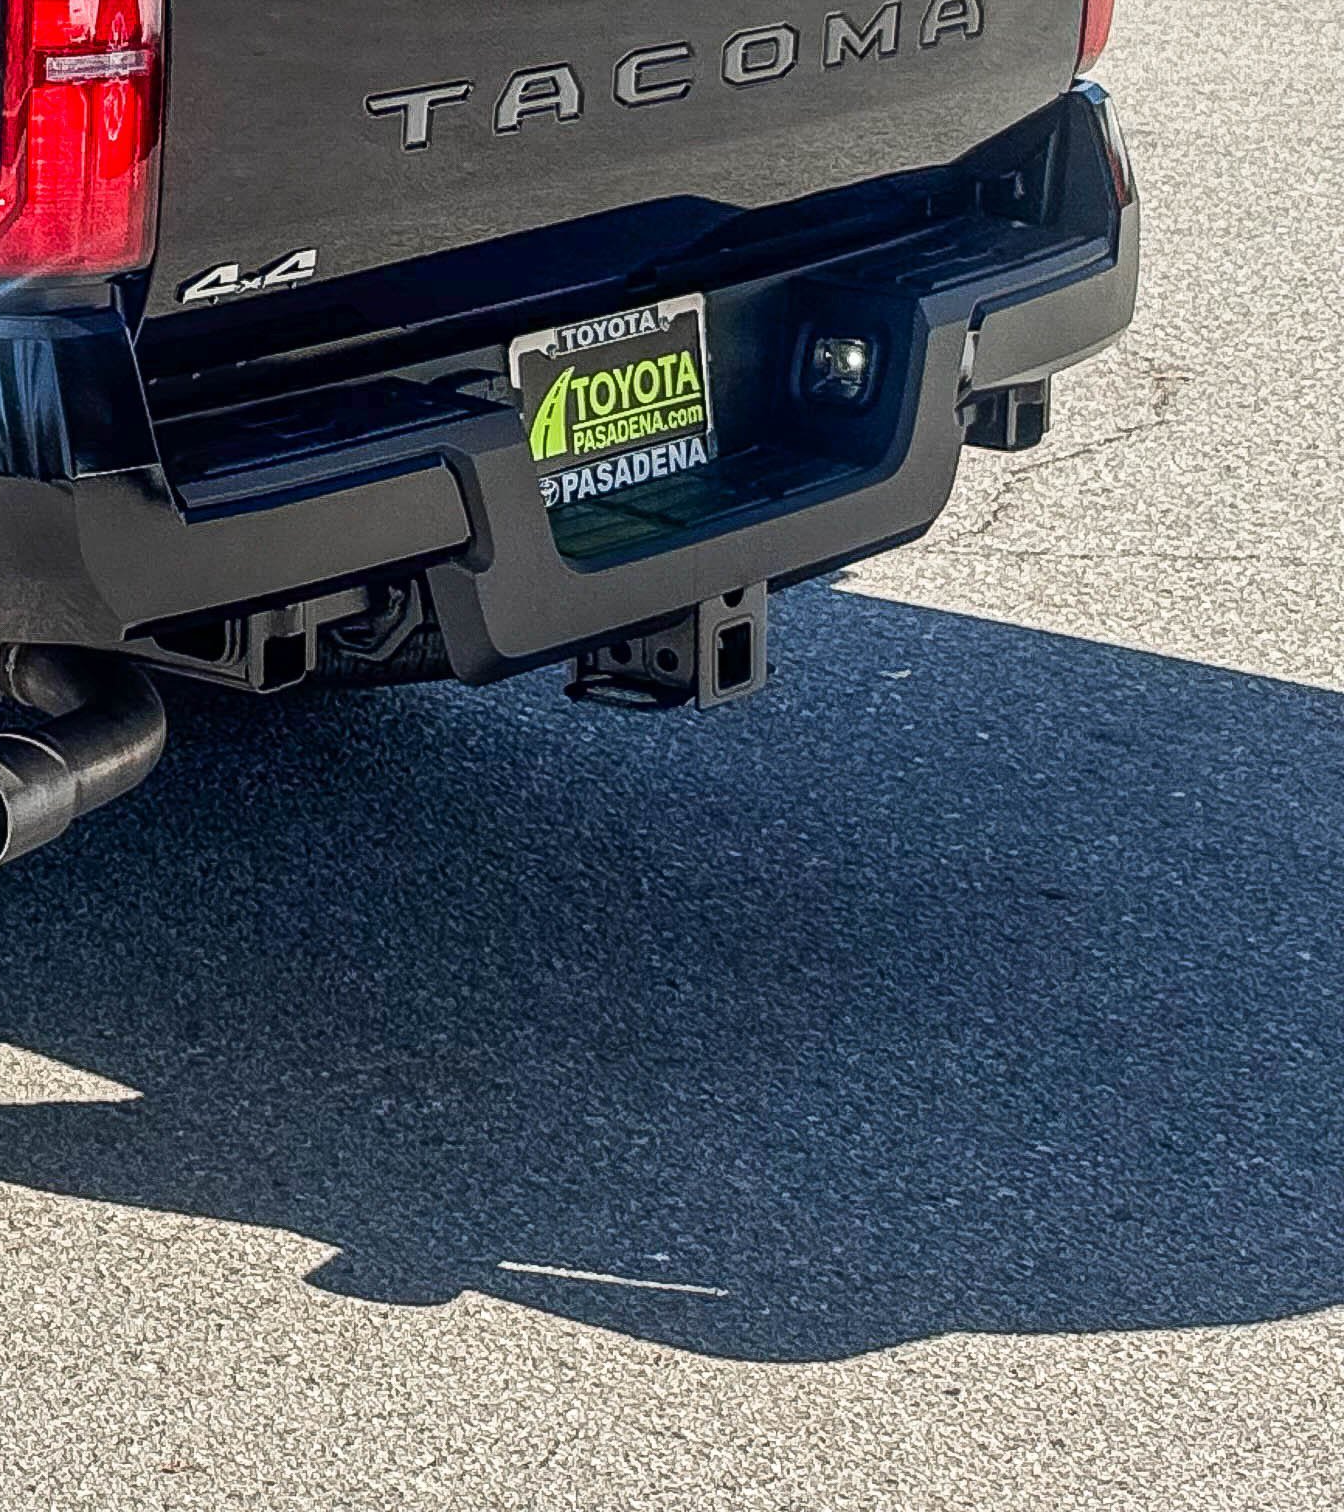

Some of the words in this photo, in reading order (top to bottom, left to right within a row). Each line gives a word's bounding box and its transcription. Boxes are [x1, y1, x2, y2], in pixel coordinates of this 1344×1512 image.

[177, 247, 317, 304] 4x4
[562, 310, 656, 351] TOYOTA
[571, 350, 700, 421] TOYOTA
[573, 404, 704, 455] PASADENA.com
[562, 438, 707, 503] PASADENA
